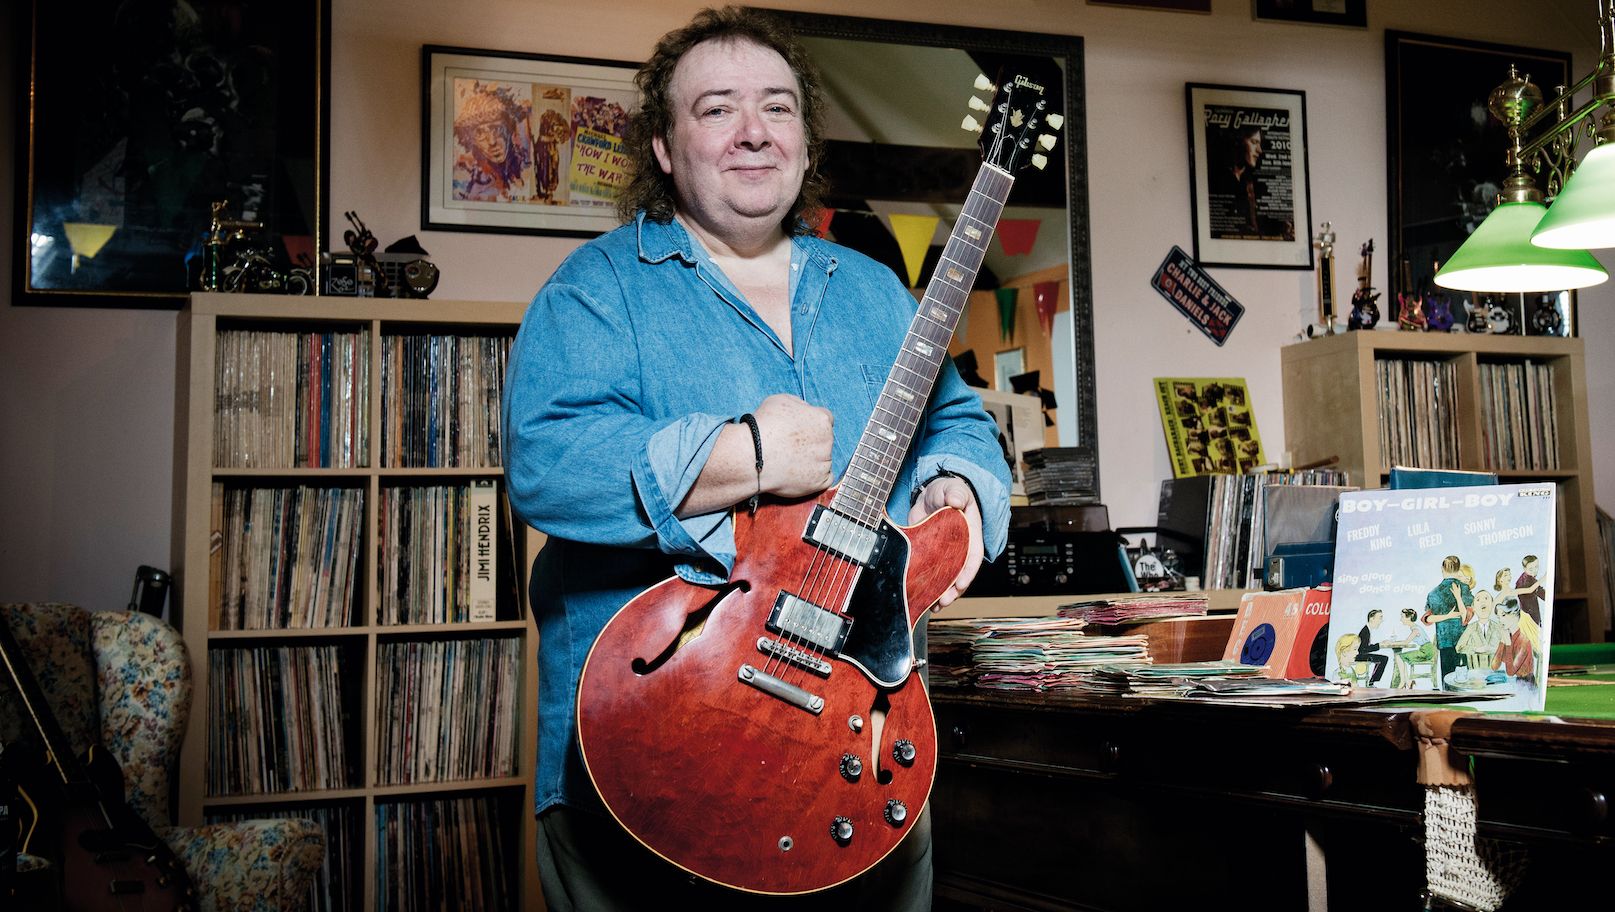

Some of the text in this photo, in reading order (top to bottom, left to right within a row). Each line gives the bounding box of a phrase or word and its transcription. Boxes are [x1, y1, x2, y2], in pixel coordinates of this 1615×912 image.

[1014, 74, 1044, 95] Gibson
[1204, 109, 1290, 130] Rory Gallagher
[1270, 141, 1291, 150] 2010
[604, 153, 610, 163] I
[577, 163, 623, 184] THE WAR
[1166, 262, 1232, 326] CHARLIE & JACK
[1174, 289, 1210, 325] DANIELS
[1347, 524, 1380, 542] FREDDY
[1407, 521, 1430, 537] LULA
[1464, 517, 1496, 535] SONNY
[1478, 524, 1534, 546] THOMPSON
[478, 504, 490, 581] JIMI HENDRIX
[1370, 535, 1392, 551] KING
[1419, 533, 1442, 549] REED
[1140, 562, 1156, 571] The
[1337, 572, 1392, 585] sing along
[1359, 584, 1426, 594] dance along
